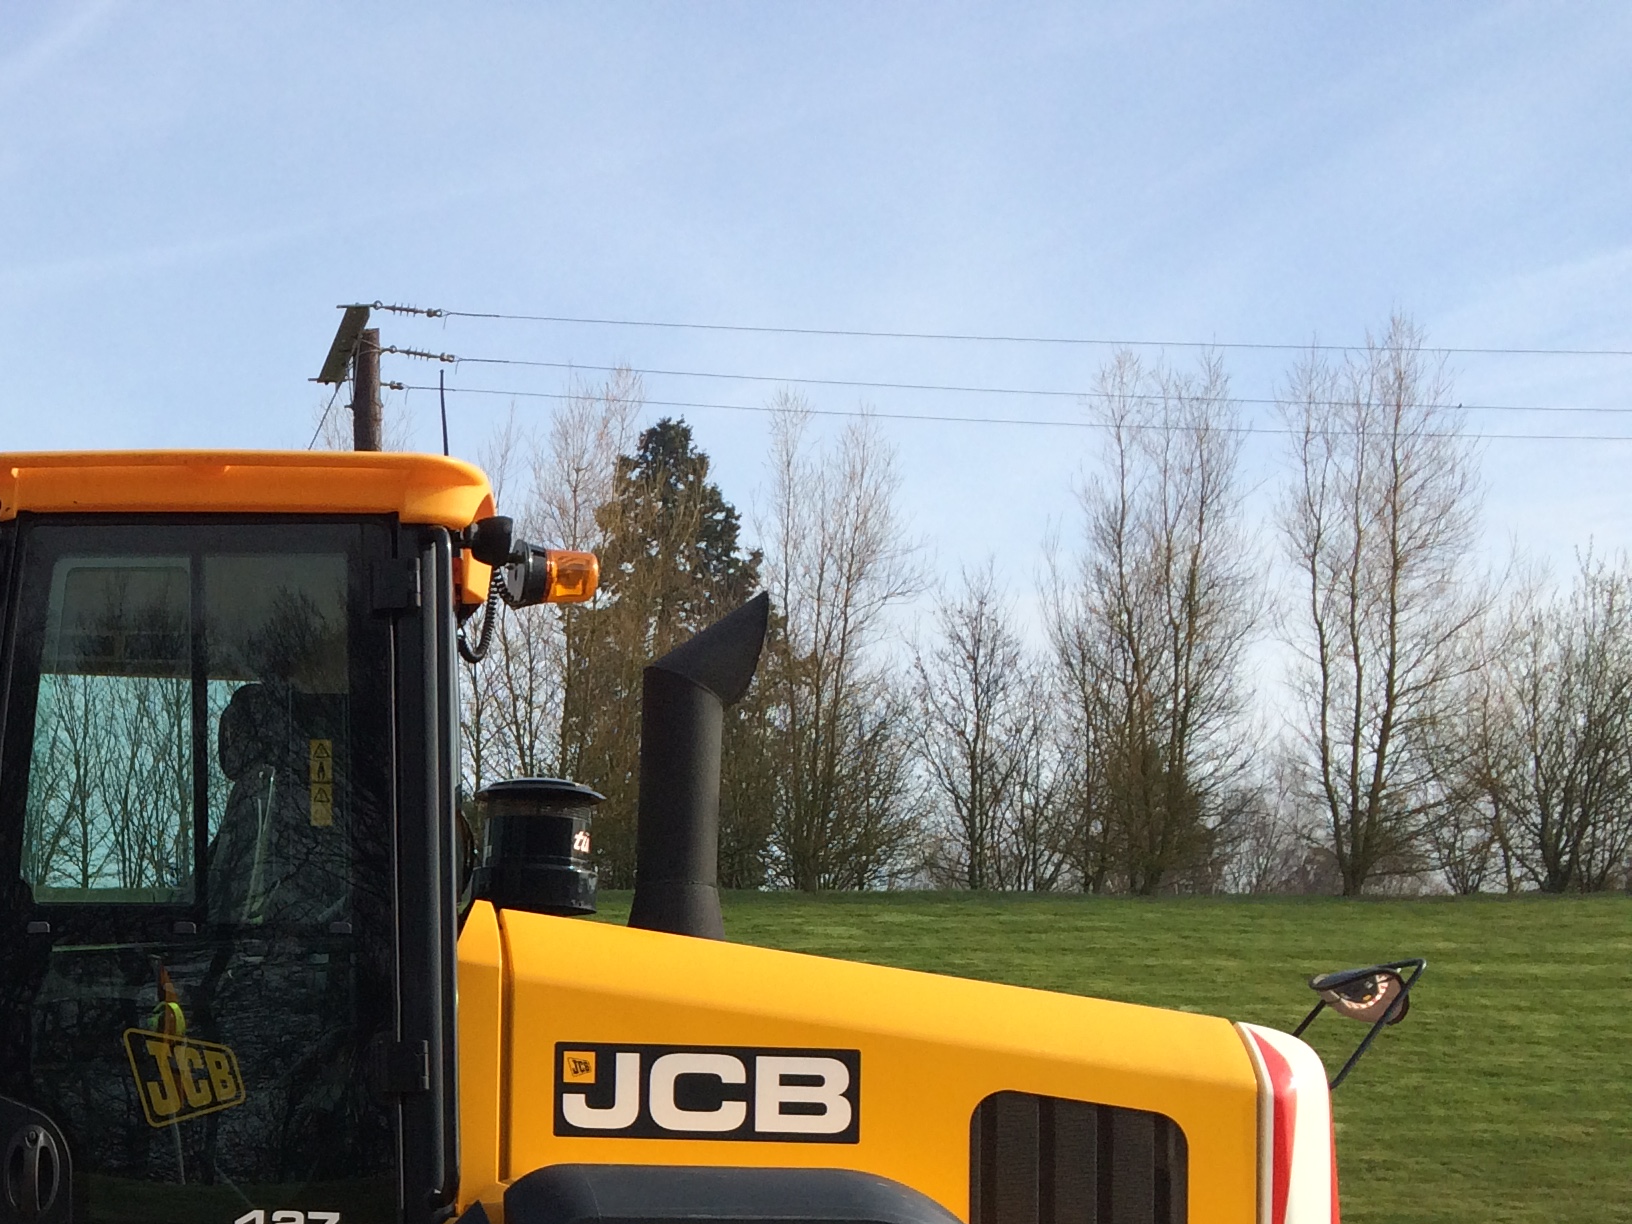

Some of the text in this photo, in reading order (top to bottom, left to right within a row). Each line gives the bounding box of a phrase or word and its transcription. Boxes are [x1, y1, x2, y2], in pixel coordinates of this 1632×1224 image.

[146, 1039, 237, 1116] JCB
[562, 1052, 852, 1134] JCB
[572, 1060, 590, 1074] JCB
